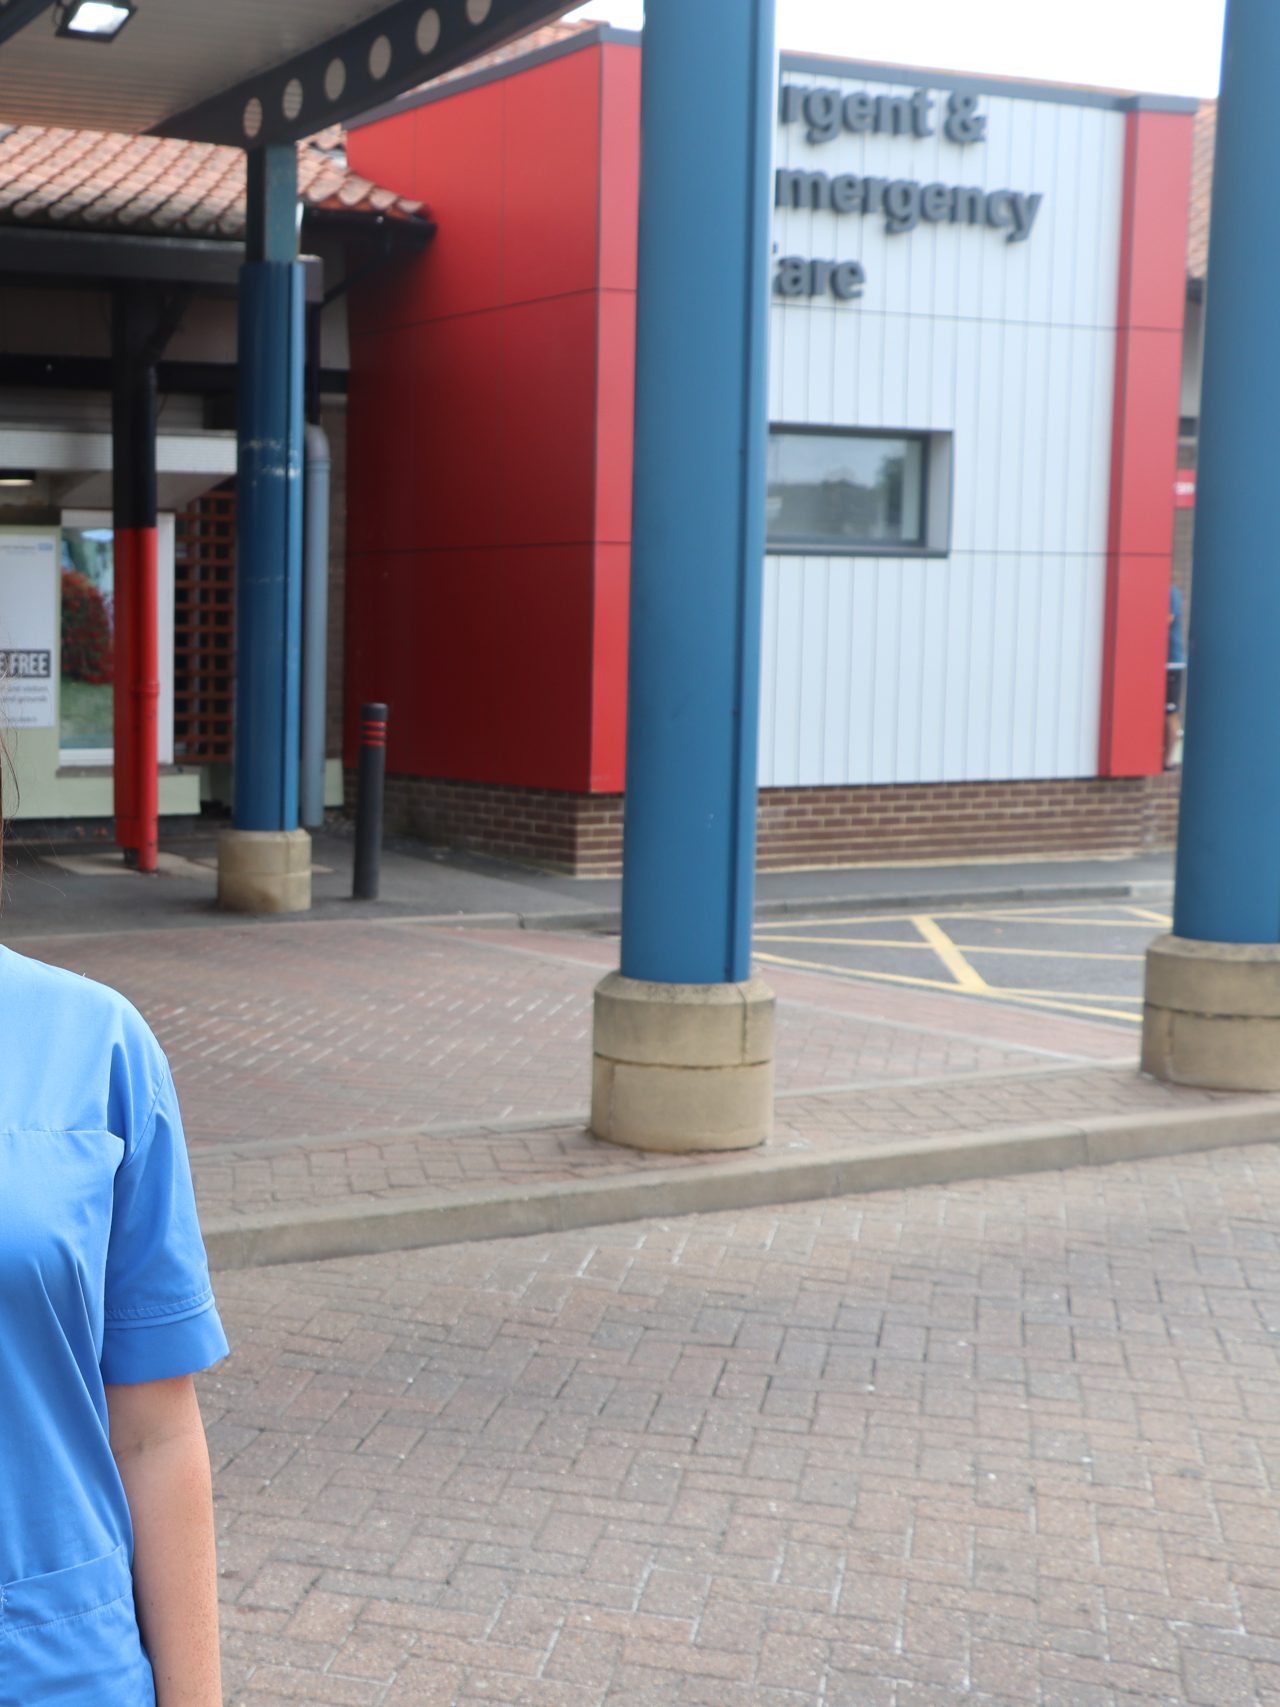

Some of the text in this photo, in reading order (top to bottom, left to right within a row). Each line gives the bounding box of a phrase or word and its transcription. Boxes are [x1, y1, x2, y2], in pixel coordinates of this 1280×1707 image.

[782, 84, 986, 145] rgent &
[775, 166, 1043, 244] mergency
[773, 252, 866, 300] are
[10, 653, 49, 675] FREE
